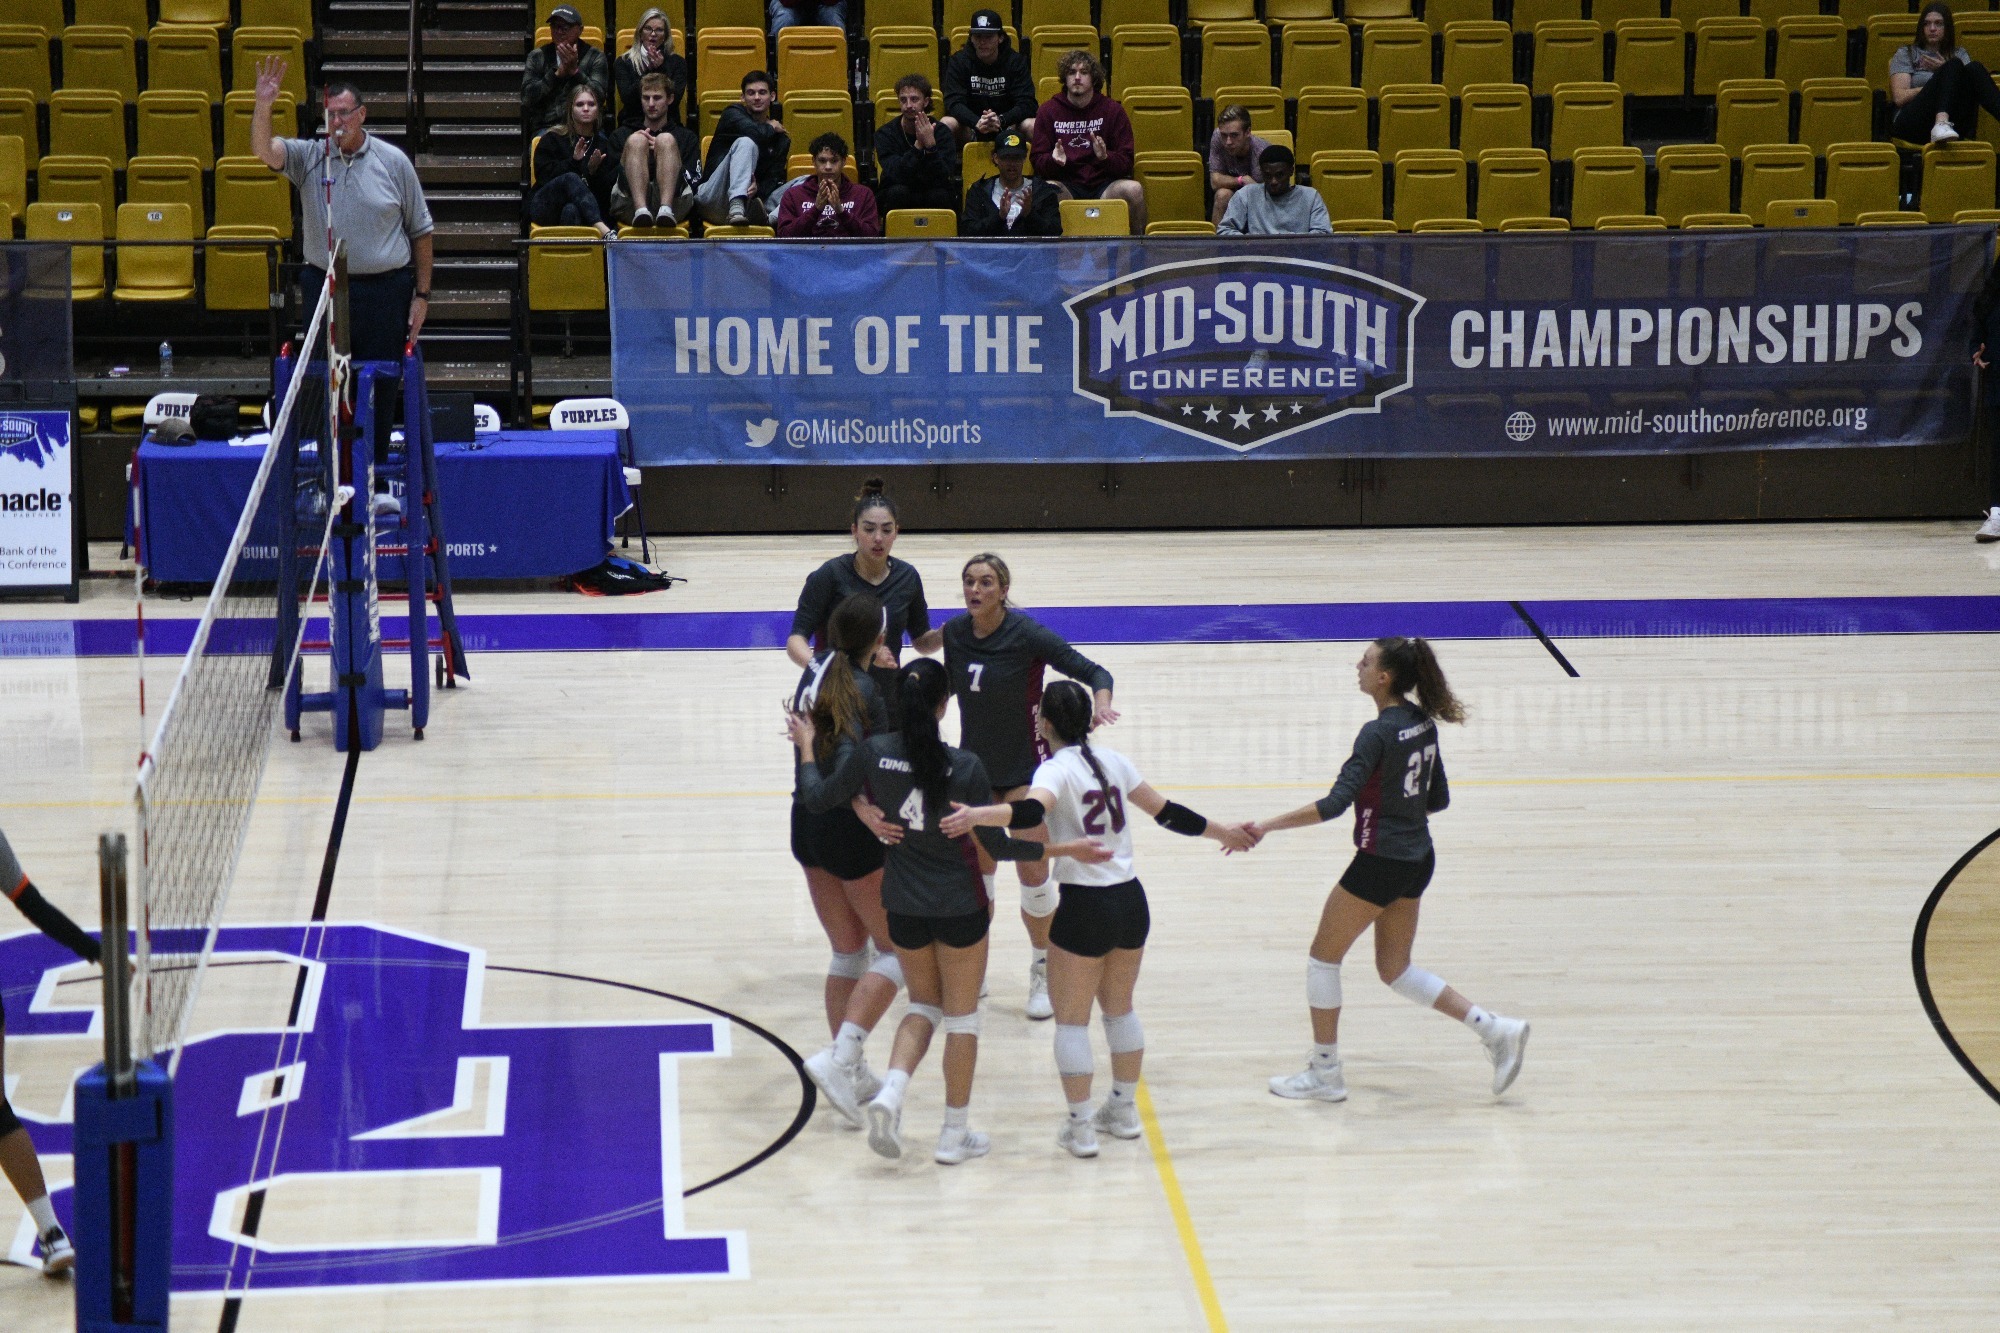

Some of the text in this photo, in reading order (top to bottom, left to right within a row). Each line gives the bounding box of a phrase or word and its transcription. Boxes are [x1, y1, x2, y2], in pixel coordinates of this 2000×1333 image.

[1053, 117, 1104, 129] CUMBERLAND
[1099, 282, 1389, 373] MID-SOUTH
[1450, 301, 1923, 369] CHAMPIONSHIPS
[674, 315, 1043, 375] HOME OF THE
[1129, 367, 1357, 390] CONFERENCE
[156, 402, 192, 418] PURP
[561, 407, 618, 424] PURPLES
[1547, 405, 1868, 437] www.mid-southconference.org
[785, 417, 982, 449] @MidSouthSports
[0, 488, 61, 512] nacle
[0, 547, 57, 556] Bank of the
[446, 543, 485, 556] PORTS
[7, 560, 67, 570] Conference
[967, 664, 985, 692] 7
[1403, 743, 1437, 798] 27
[898, 787, 925, 831] 4
[1081, 785, 1127, 836] 20
[1360, 808, 1373, 849] RISE
